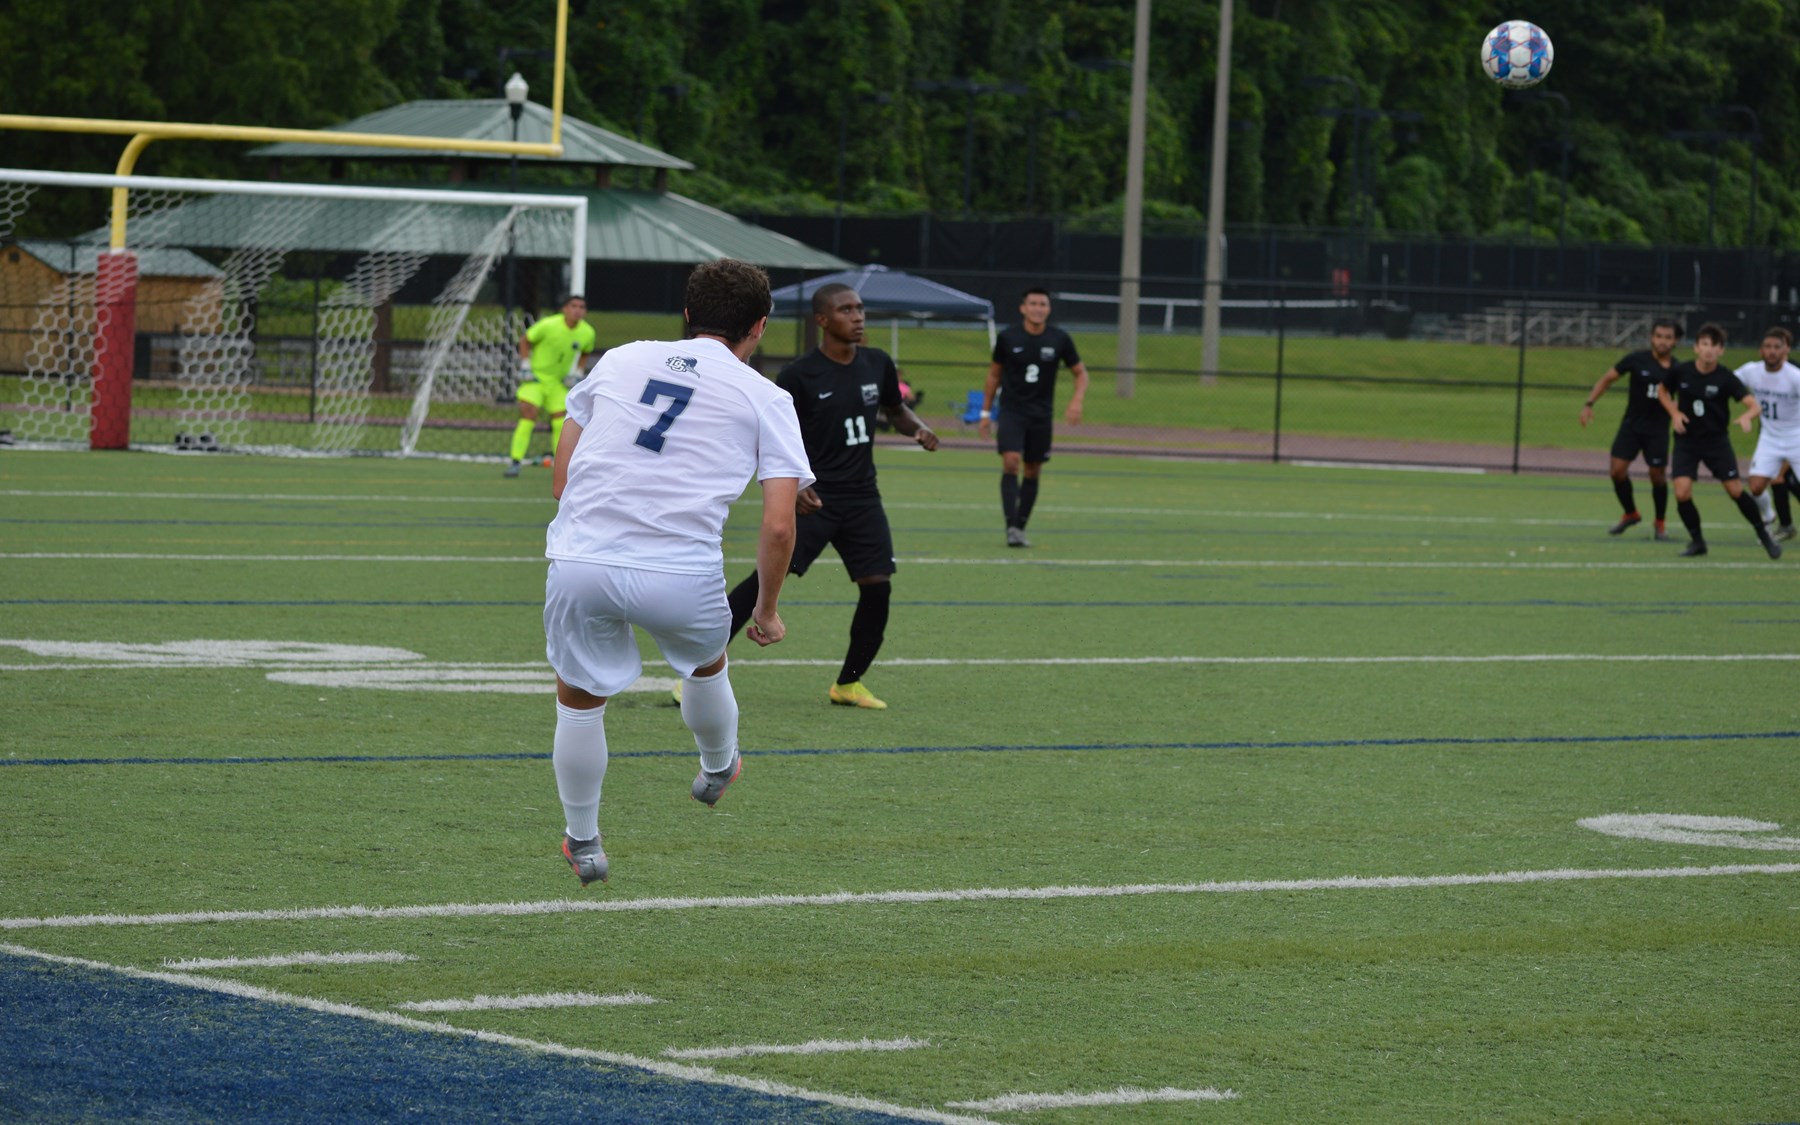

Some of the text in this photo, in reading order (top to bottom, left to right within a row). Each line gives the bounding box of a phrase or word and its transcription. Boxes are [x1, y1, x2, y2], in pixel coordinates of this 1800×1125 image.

[1025, 363, 1040, 383] 2
[633, 377, 696, 455] 7
[1760, 400, 1778, 420] 21
[844, 415, 870, 446] 11
